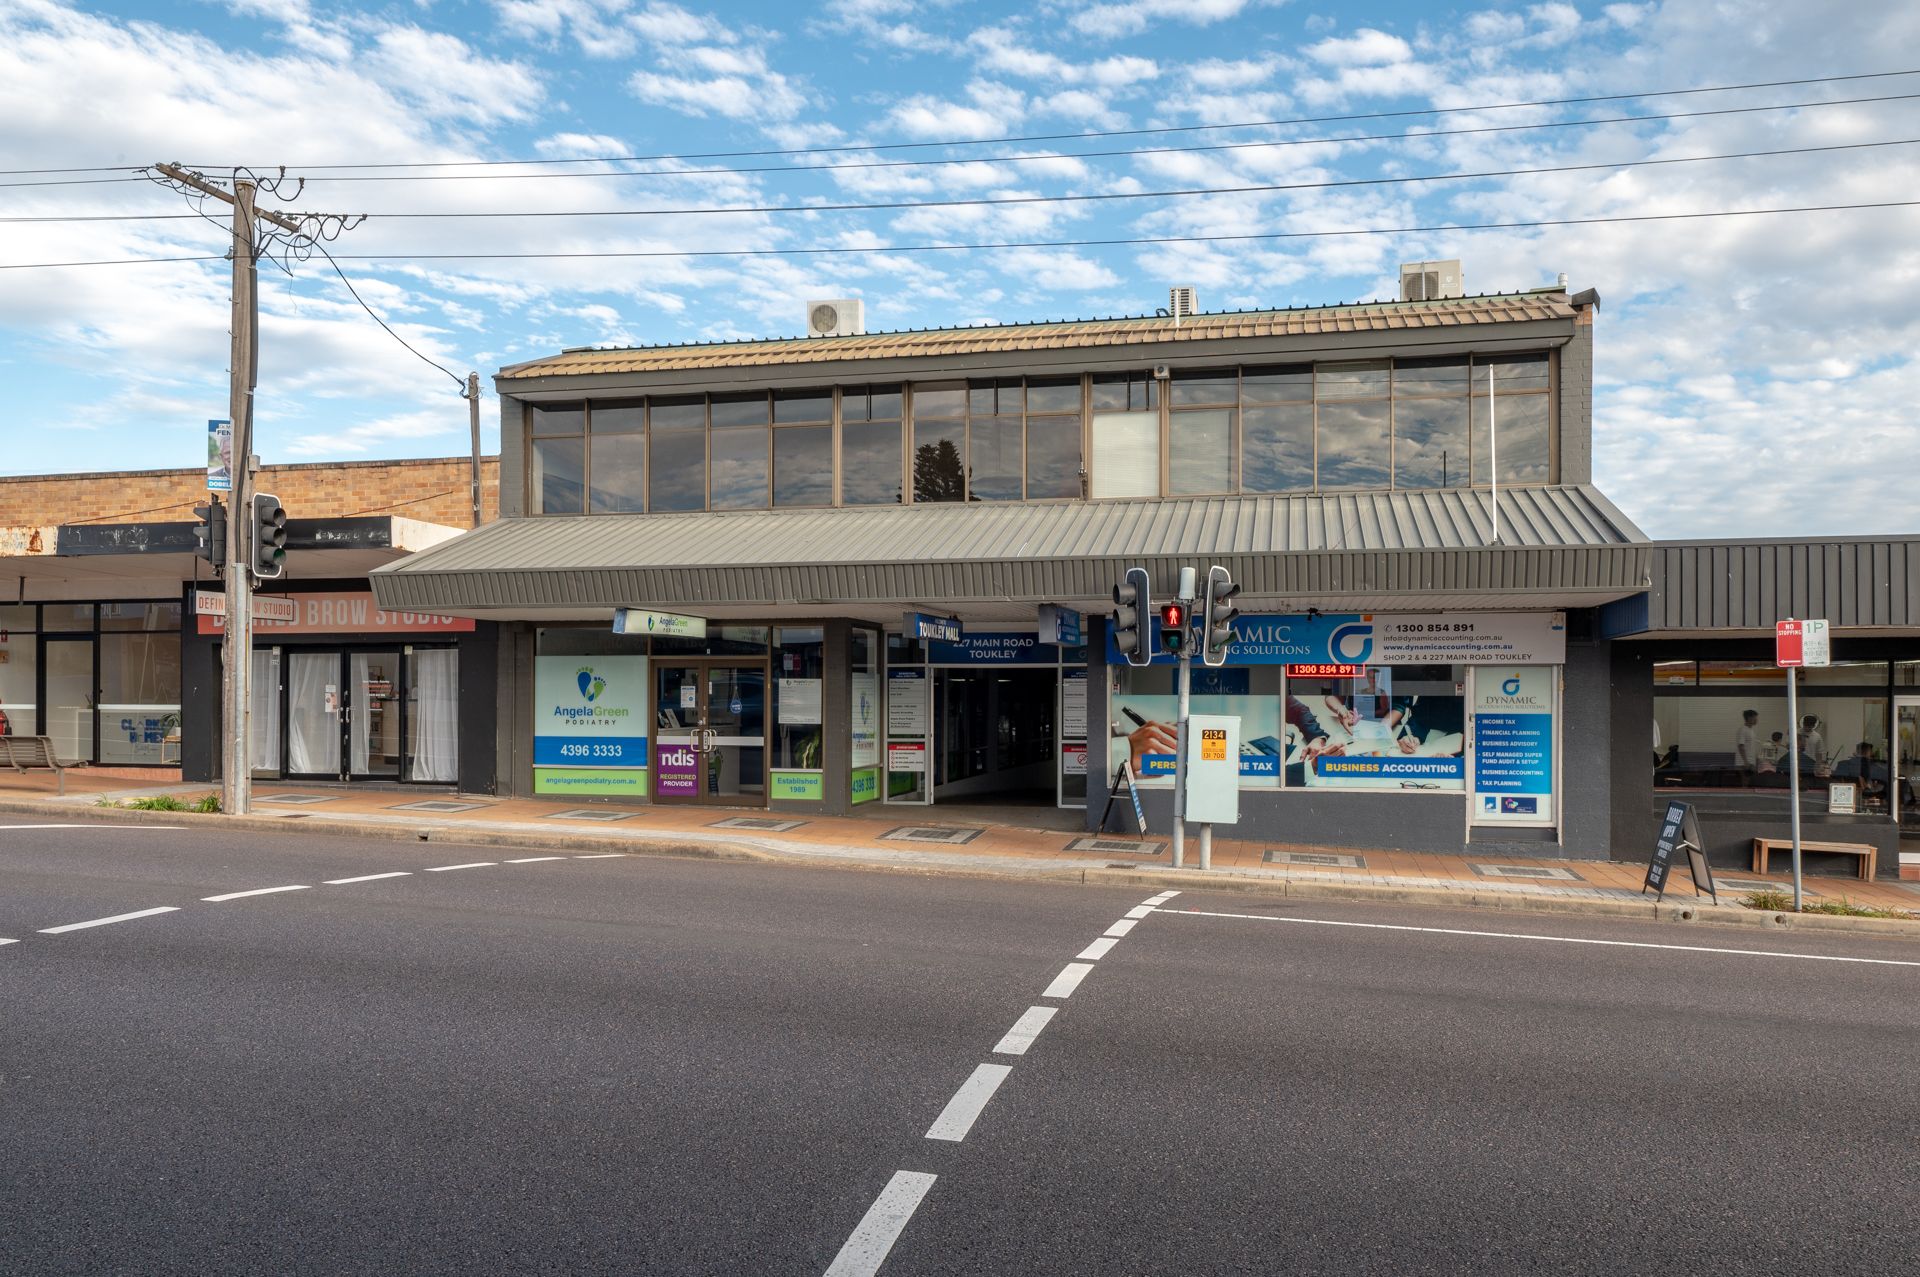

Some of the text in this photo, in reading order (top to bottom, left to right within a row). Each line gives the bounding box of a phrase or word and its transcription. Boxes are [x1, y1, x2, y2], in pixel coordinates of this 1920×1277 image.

[198, 596, 225, 610] DEFIN
[263, 603, 291, 616] STUDIO
[307, 599, 367, 625] BROW
[659, 617, 688, 628] AngelaGreen
[919, 622, 960, 642] TOUKLEY MALL
[1396, 624, 1475, 633] 1300 854 891
[1383, 634, 1503, 642] info@dynamicaccounting.com.au
[1003, 639, 1034, 647] ROAD
[1383, 643, 1513, 651] www.dynamicaccounting.com.au
[969, 650, 1017, 658] TOUKLEY
[1243, 645, 1311, 655] SOLUTIONS
[1294, 665, 1356, 673] 1300 854 891
[1485, 696, 1537, 704] DYNAMIC
[553, 705, 629, 718] AngelaGreen
[1204, 730, 1224, 739] 2134
[560, 744, 623, 757] 4396 3333
[661, 749, 695, 766] ndis
[1150, 761, 1177, 769] PERS
[1252, 762, 1273, 770] TAX
[1325, 763, 1457, 773] BUSINESS ACCOUNTING
[545, 777, 637, 786] angelagreenpodiatry.com.au
[777, 777, 818, 785] Established
